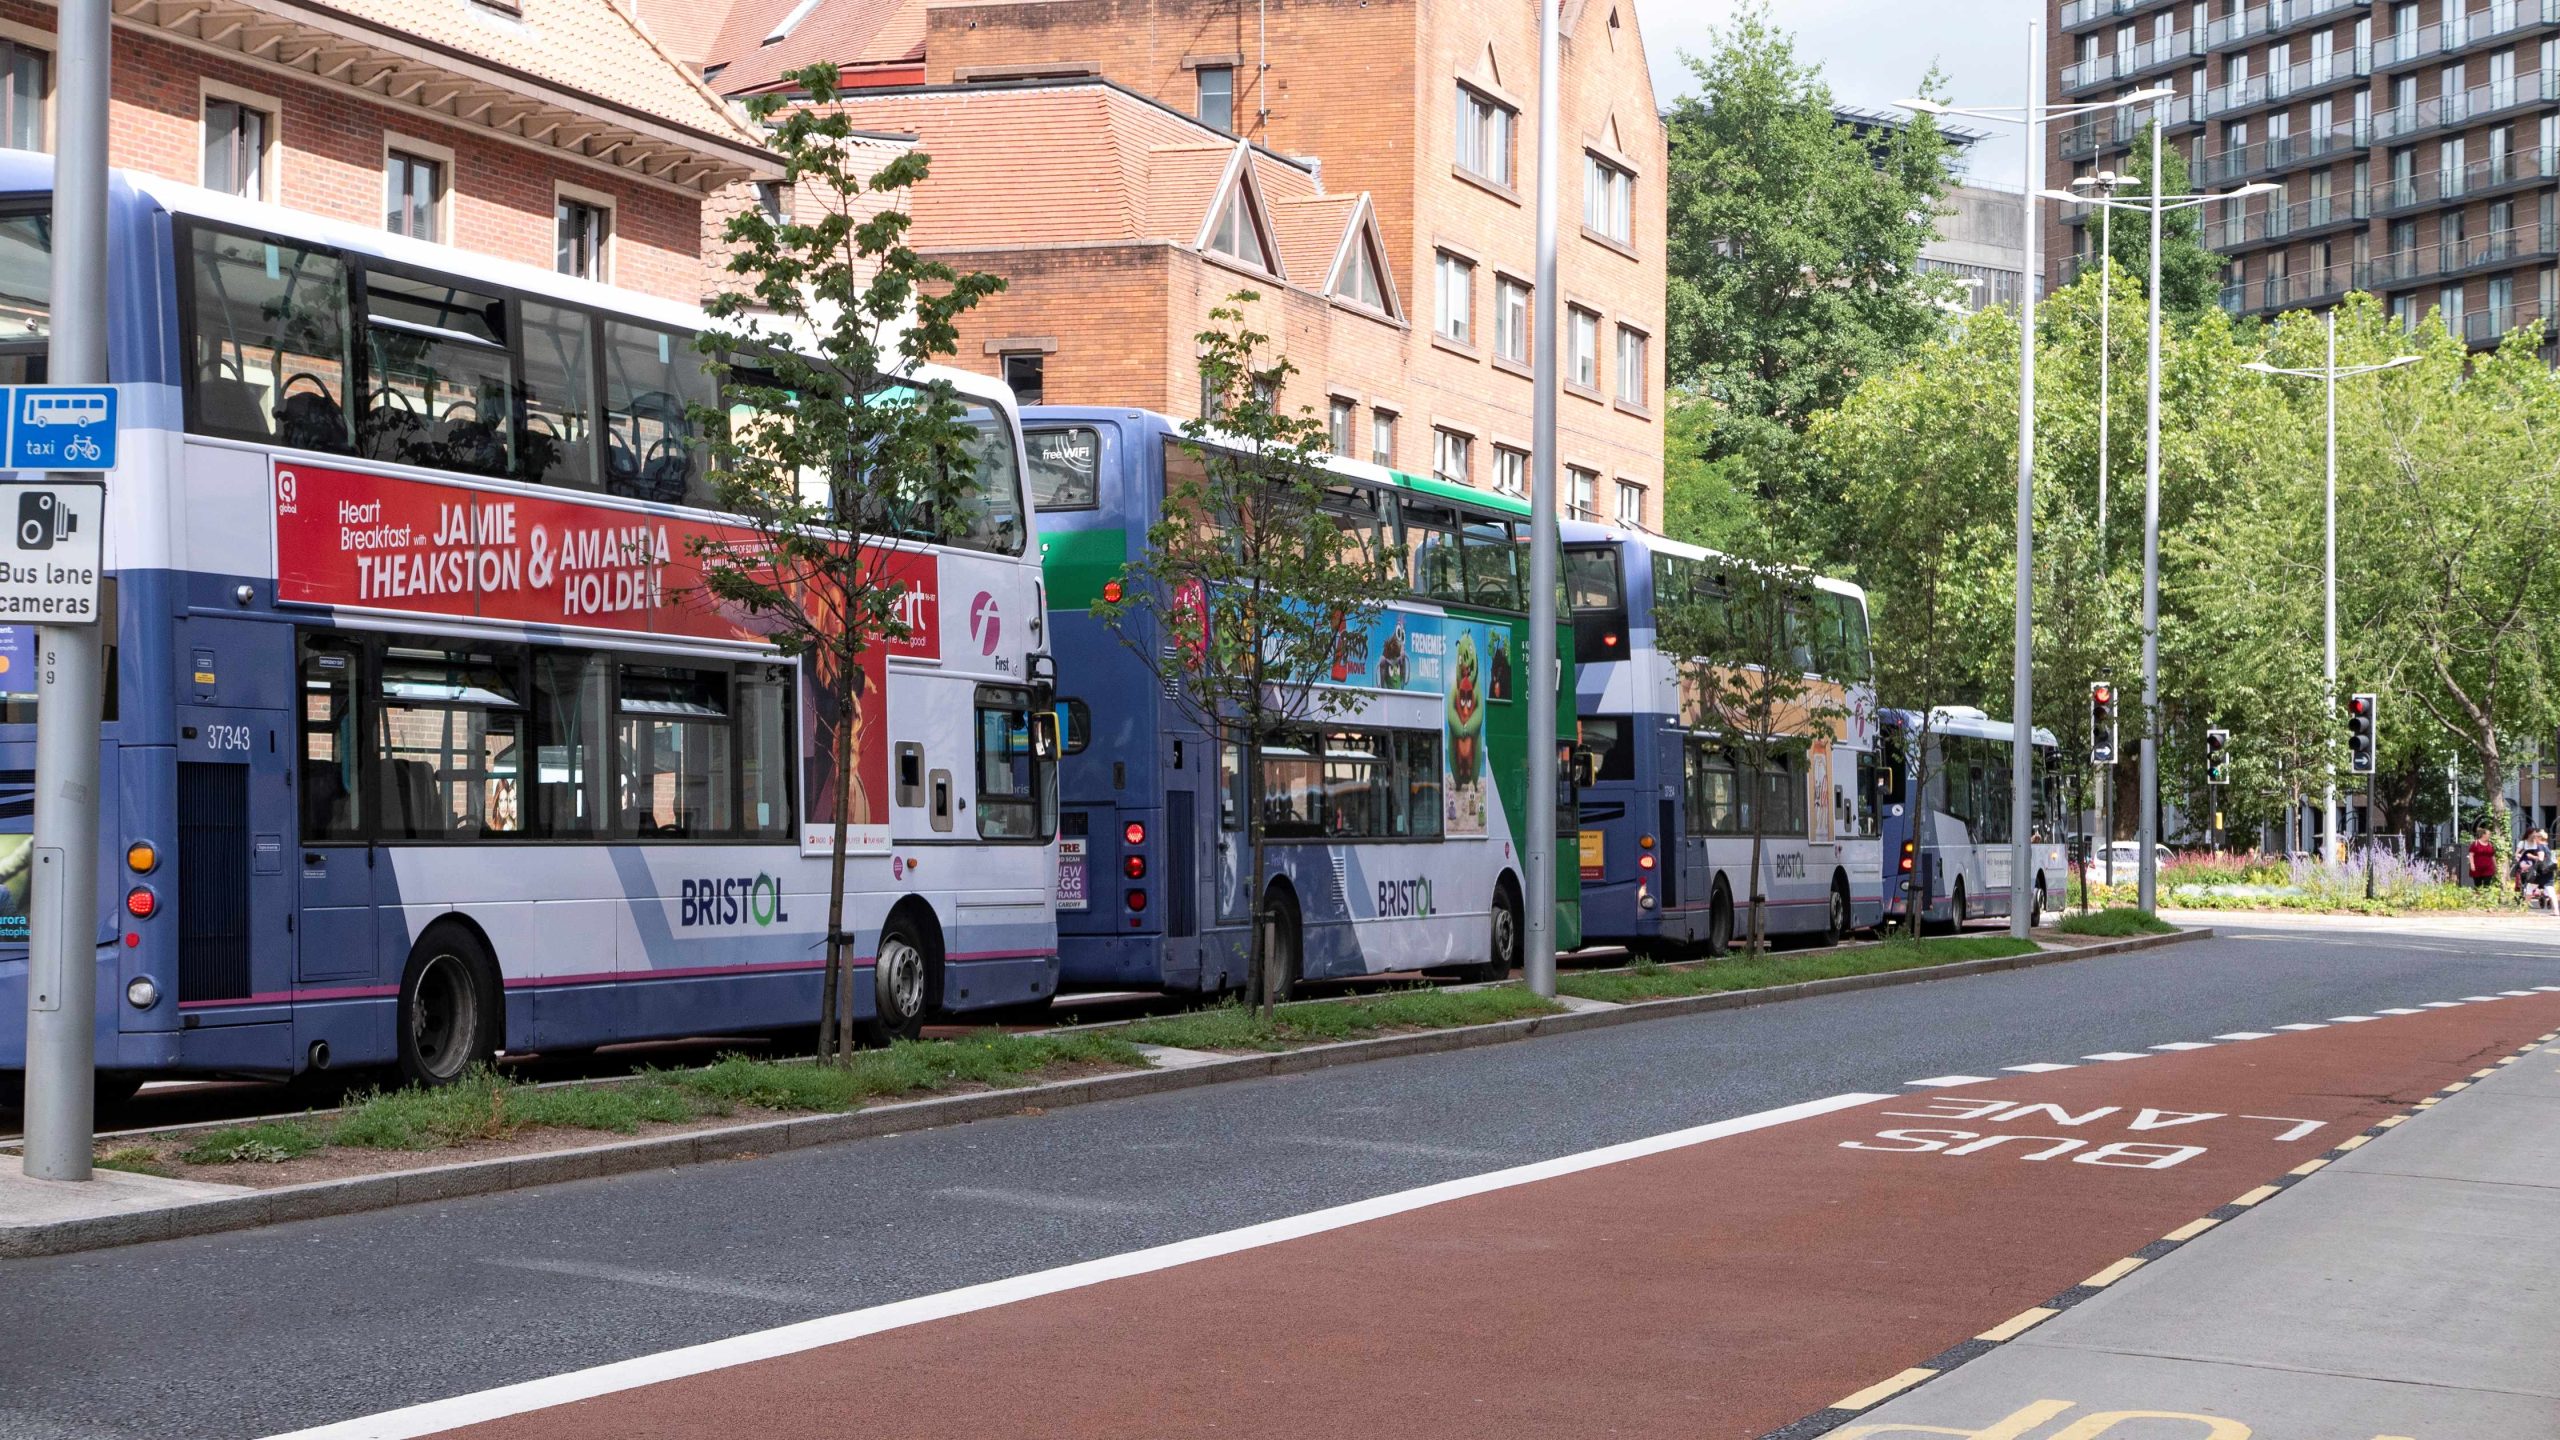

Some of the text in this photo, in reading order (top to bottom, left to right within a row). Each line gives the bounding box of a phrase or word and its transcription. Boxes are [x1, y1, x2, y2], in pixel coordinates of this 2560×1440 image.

[26, 439, 55, 455] taxi
[1043, 446, 1090, 460] free WiFi
[279, 504, 297, 515] global
[339, 499, 381, 524] Heart
[341, 502, 516, 550] Breakfast with JAMIE
[528, 525, 671, 589] & AMANDA
[0, 562, 93, 585] Bus lane
[358, 548, 521, 599] THEAKSTON
[0, 596, 90, 614] cameras
[564, 570, 662, 616] HOLDEN
[1411, 632, 1447, 656] FRENEMIES
[47, 652, 56, 666] S
[995, 655, 1010, 672] First
[1418, 657, 1440, 680] UNITE
[207, 724, 250, 750] 37343
[1776, 851, 1806, 879] BRISTOL
[681, 871, 788, 927] BRISTOL
[1057, 890, 1082, 899] RAMS
[1378, 875, 1437, 918] BRISTOL
[1880, 1096, 2328, 1141] LANE
[1837, 1128, 2208, 1169] BUS
